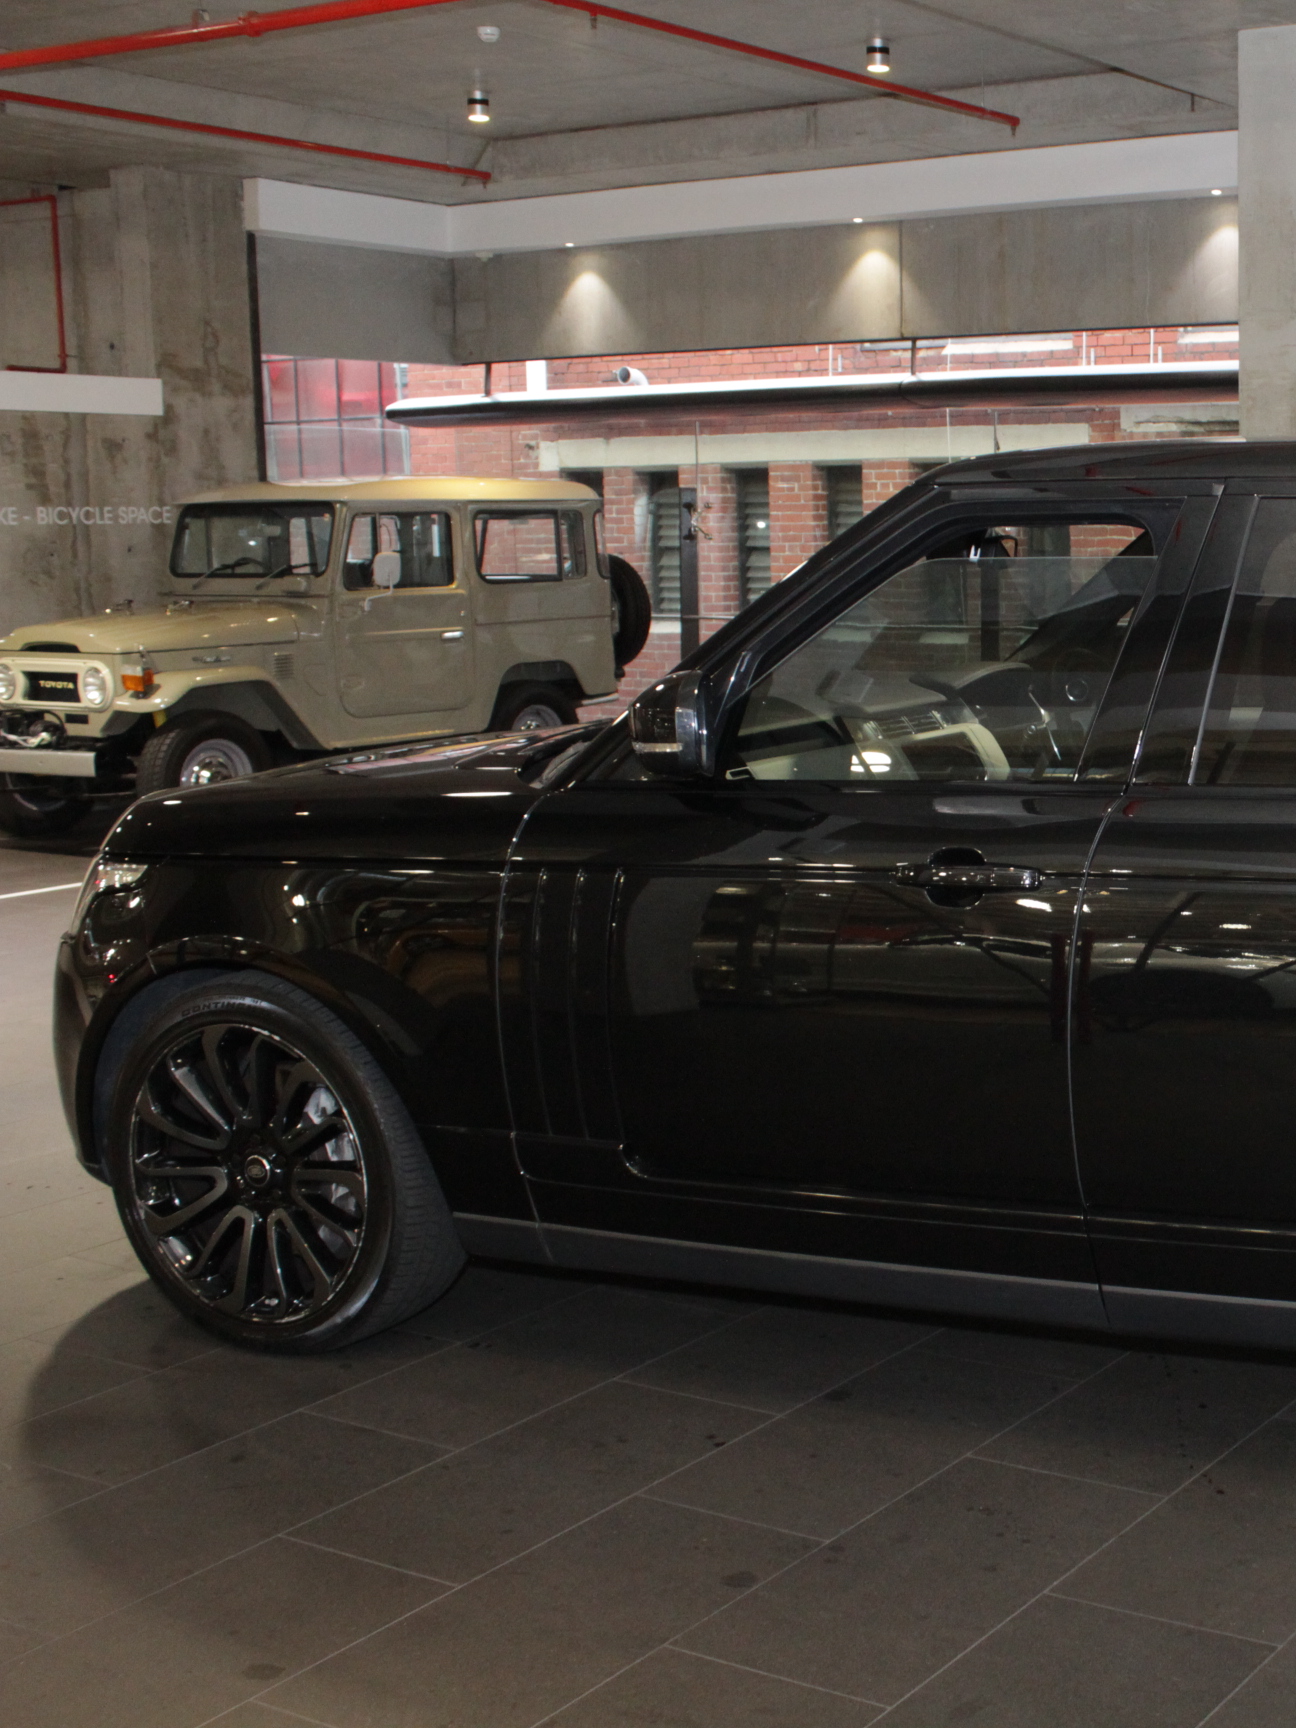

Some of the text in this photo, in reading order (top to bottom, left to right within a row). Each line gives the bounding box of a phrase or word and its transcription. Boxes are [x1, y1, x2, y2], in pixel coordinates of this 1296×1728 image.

[36, 506, 113, 525] BICYCLE
[118, 506, 172, 524] SPACE
[39, 680, 75, 689] TOYOTA
